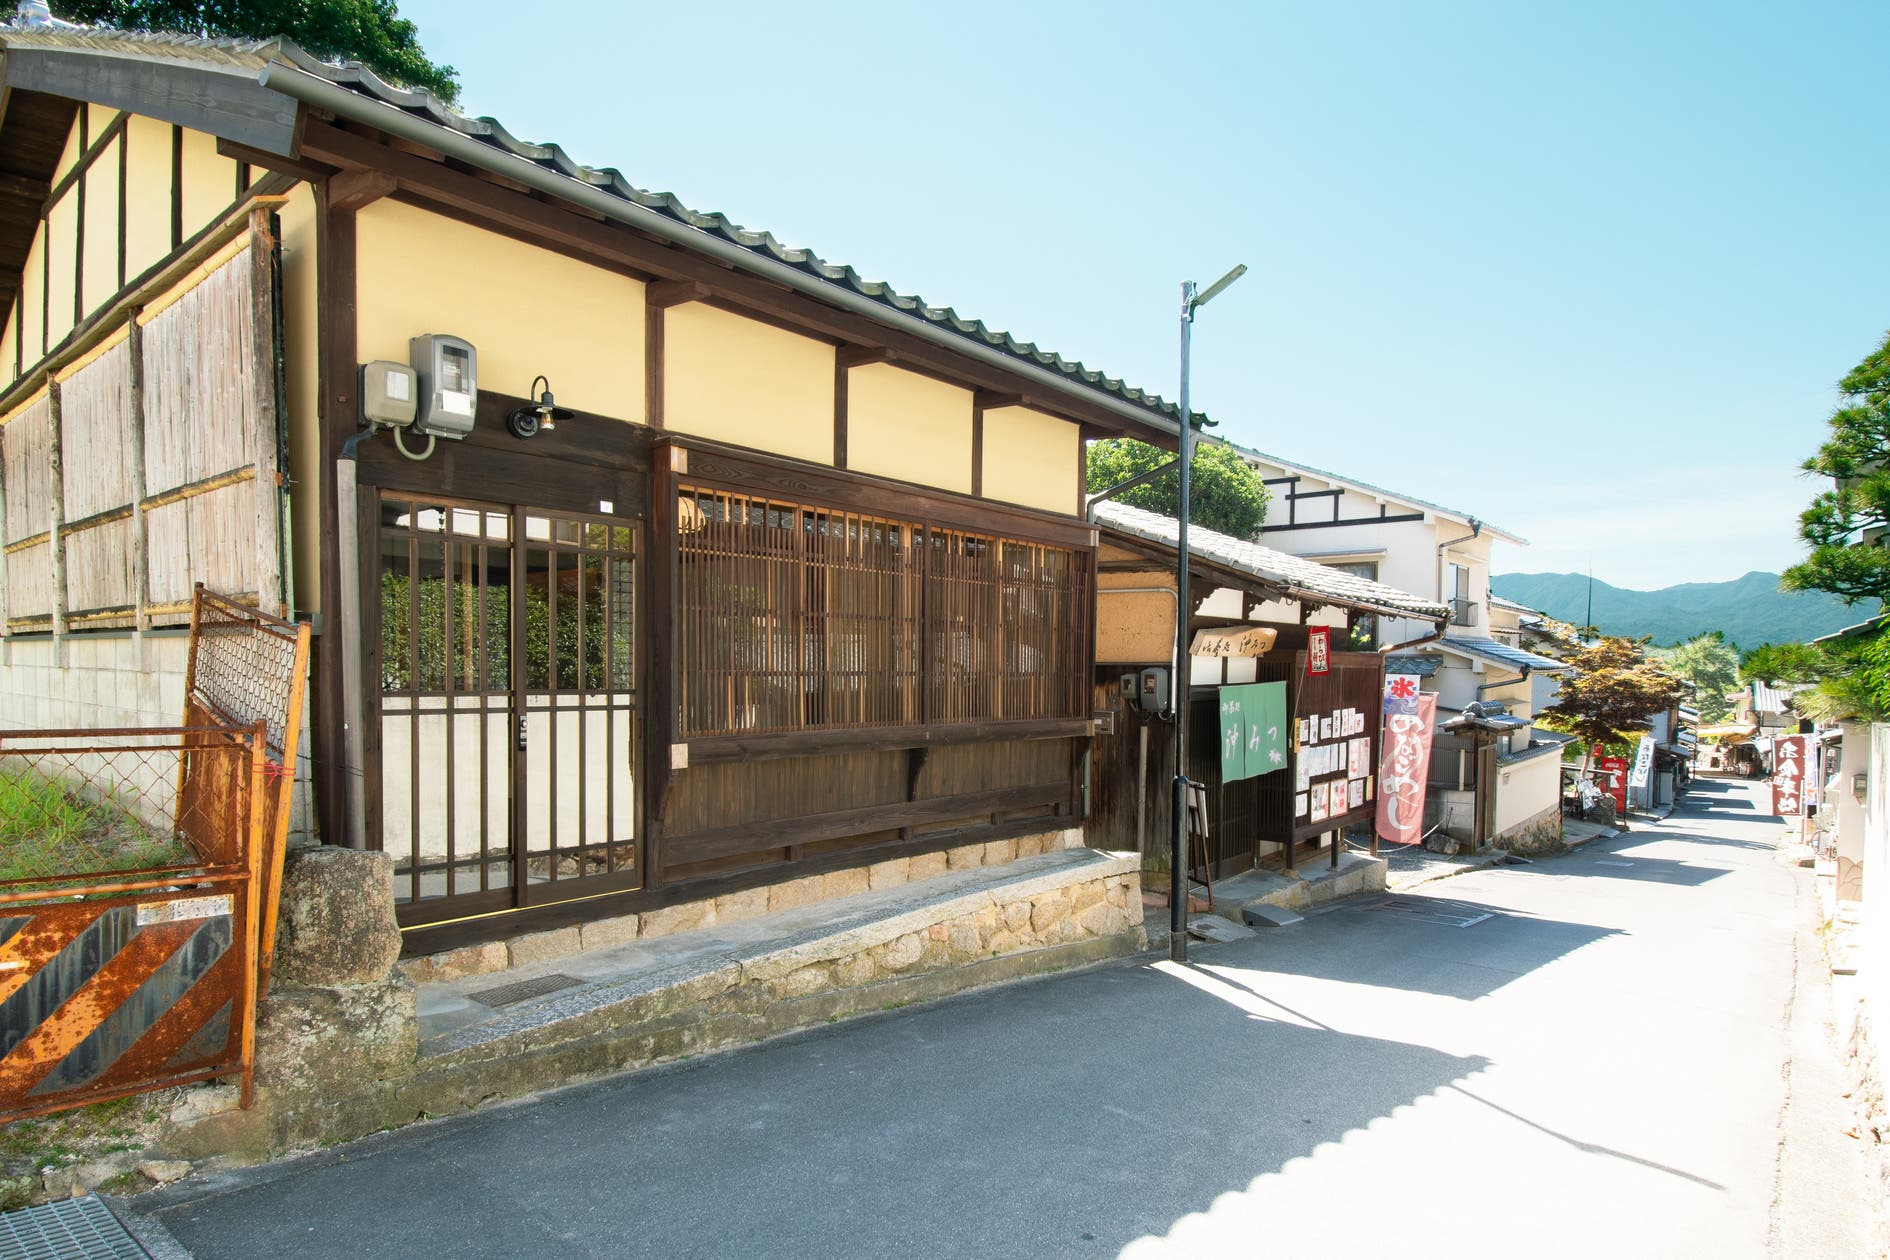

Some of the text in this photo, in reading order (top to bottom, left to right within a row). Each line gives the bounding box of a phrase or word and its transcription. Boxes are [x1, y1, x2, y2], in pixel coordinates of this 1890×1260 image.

[1391, 677, 1415, 698] 氷
[1777, 741, 1799, 812] お食事処
